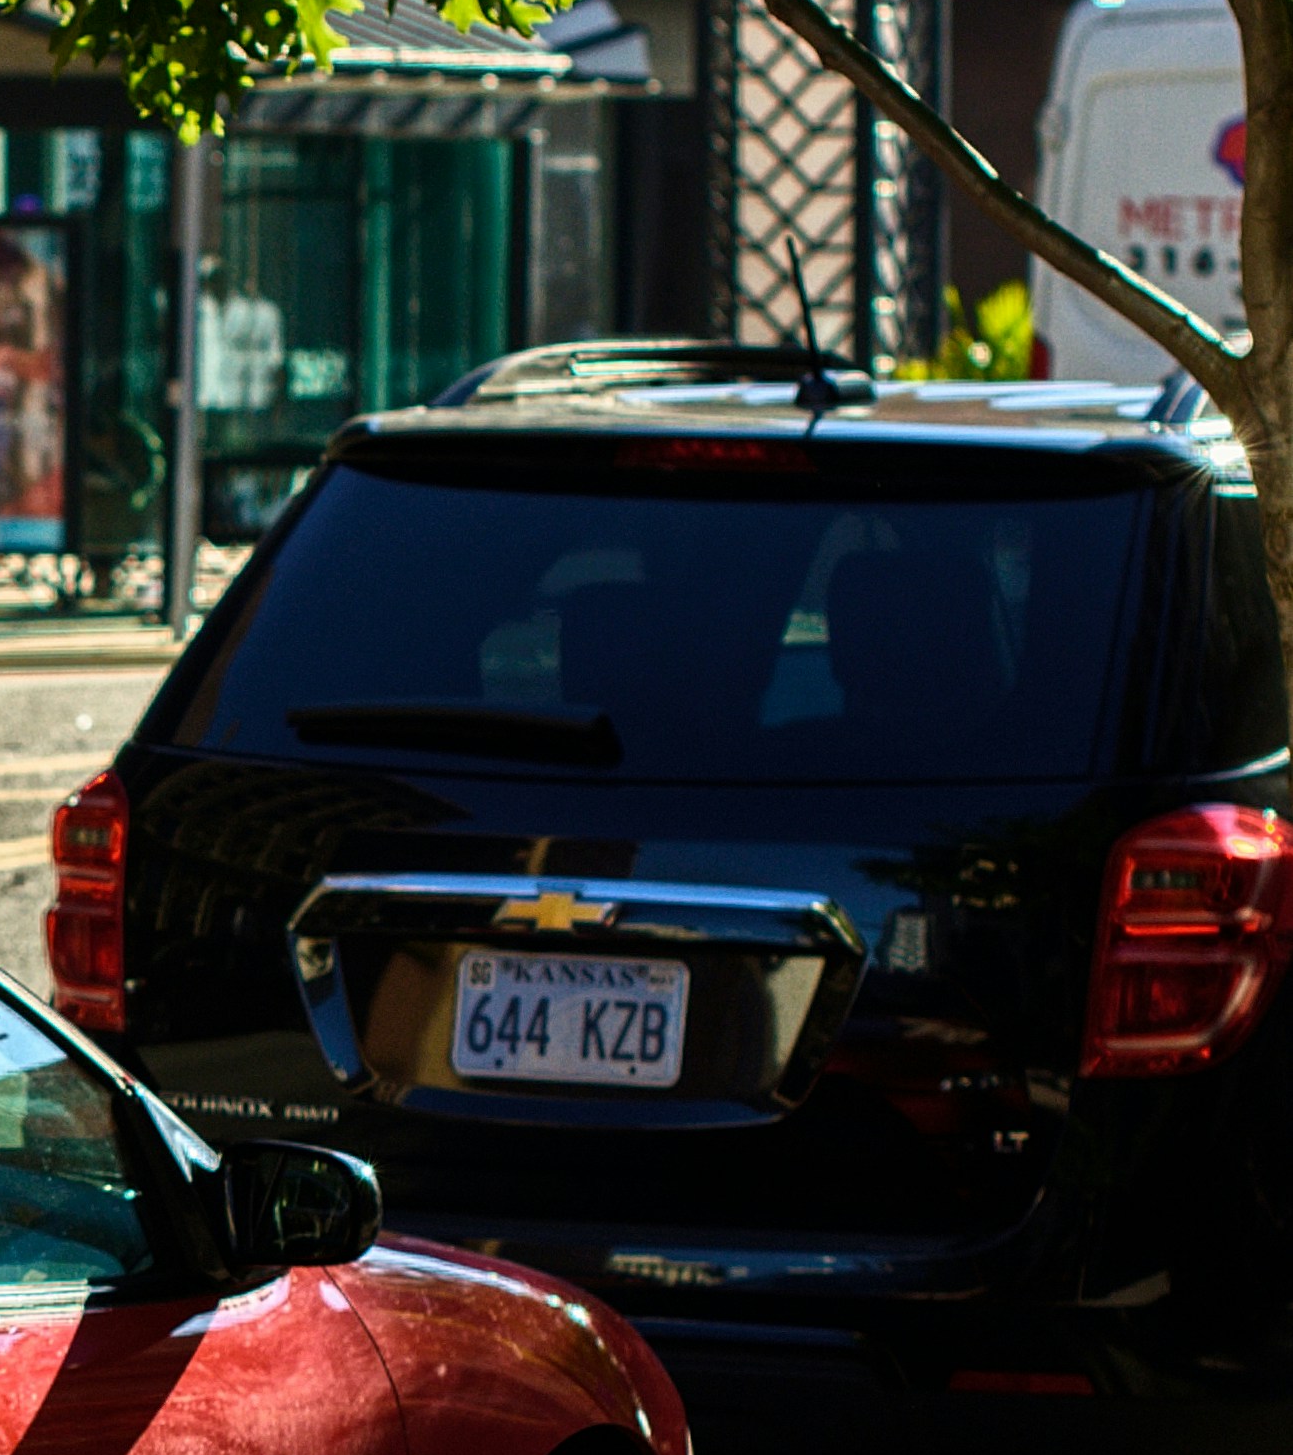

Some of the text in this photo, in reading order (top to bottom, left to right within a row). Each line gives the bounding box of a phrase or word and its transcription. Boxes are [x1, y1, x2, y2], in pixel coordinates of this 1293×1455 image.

[515, 962, 635, 987] KANSAS
[467, 992, 668, 1064] 644 KZB
[992, 1129, 1030, 1155] LT
